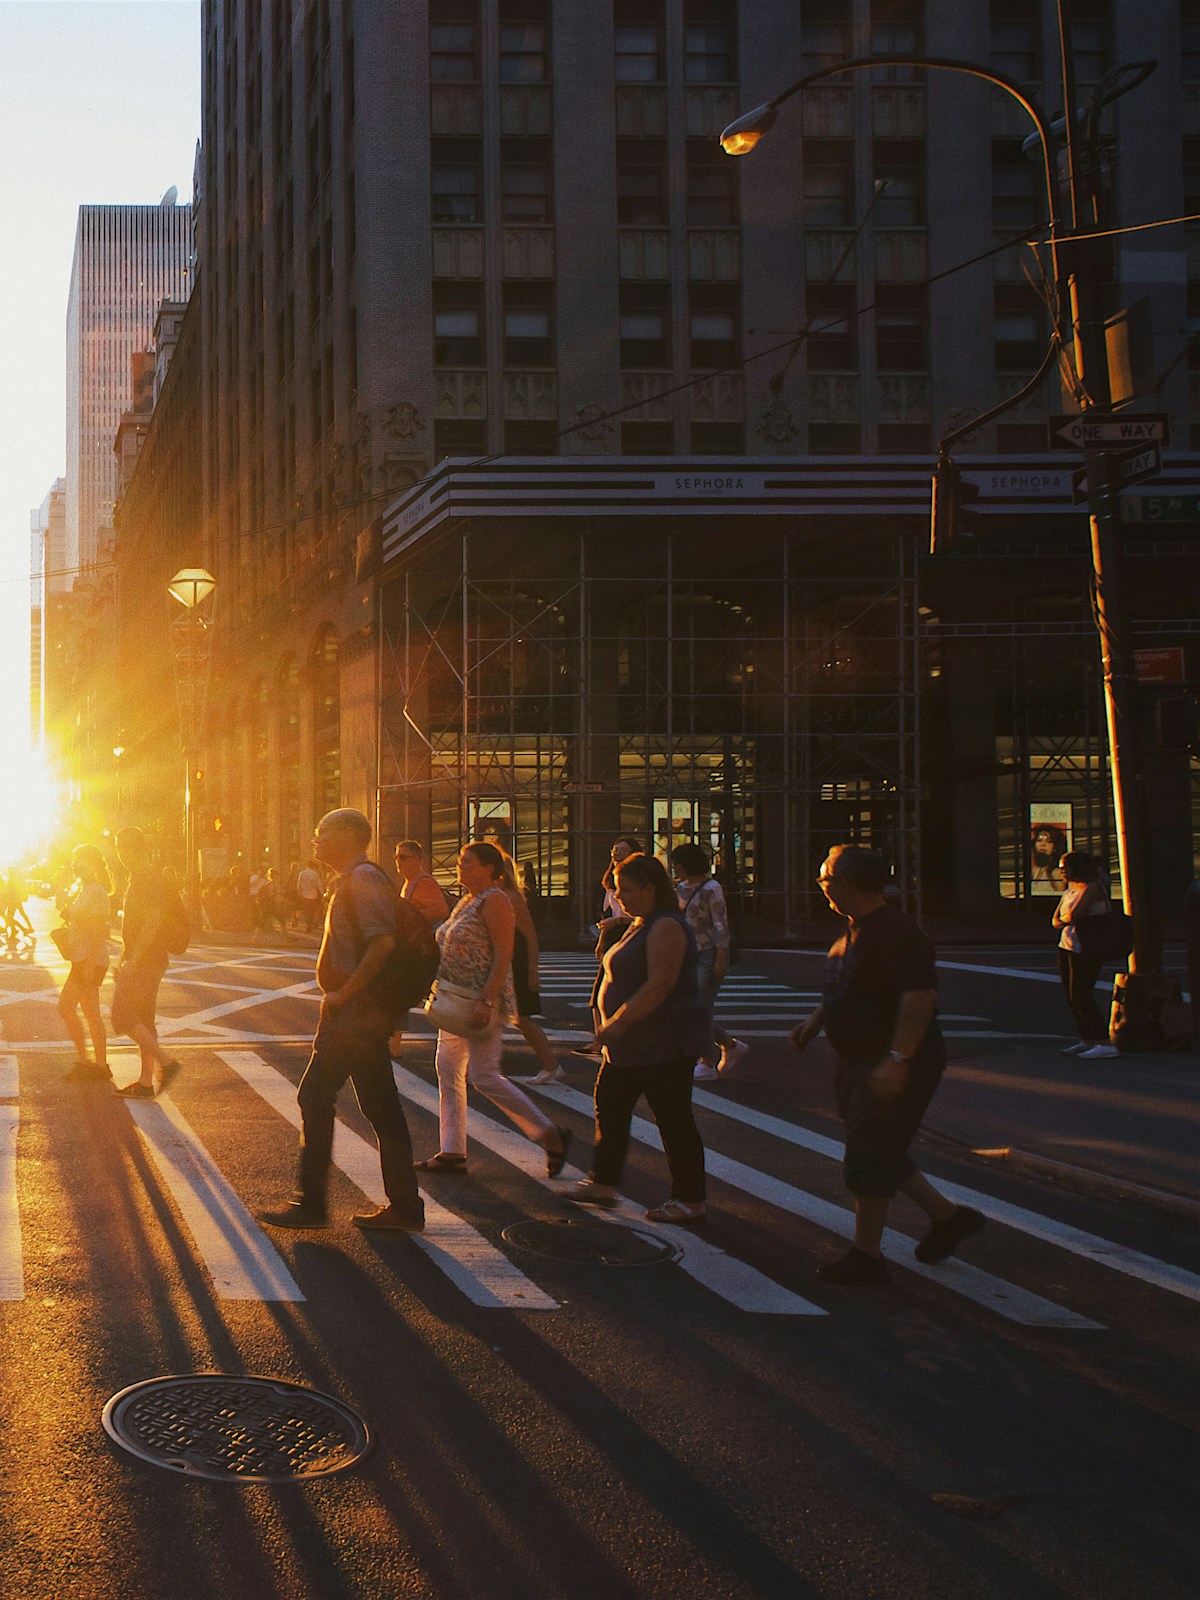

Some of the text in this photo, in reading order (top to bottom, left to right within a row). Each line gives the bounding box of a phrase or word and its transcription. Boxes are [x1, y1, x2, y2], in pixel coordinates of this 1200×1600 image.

[1072, 423, 1155, 439] ONE WAY
[1122, 453, 1151, 475] WAY
[676, 478, 743, 489] SEPHORA
[992, 477, 1060, 488] SEPHORA
[1149, 498, 1184, 519] 5 AV
